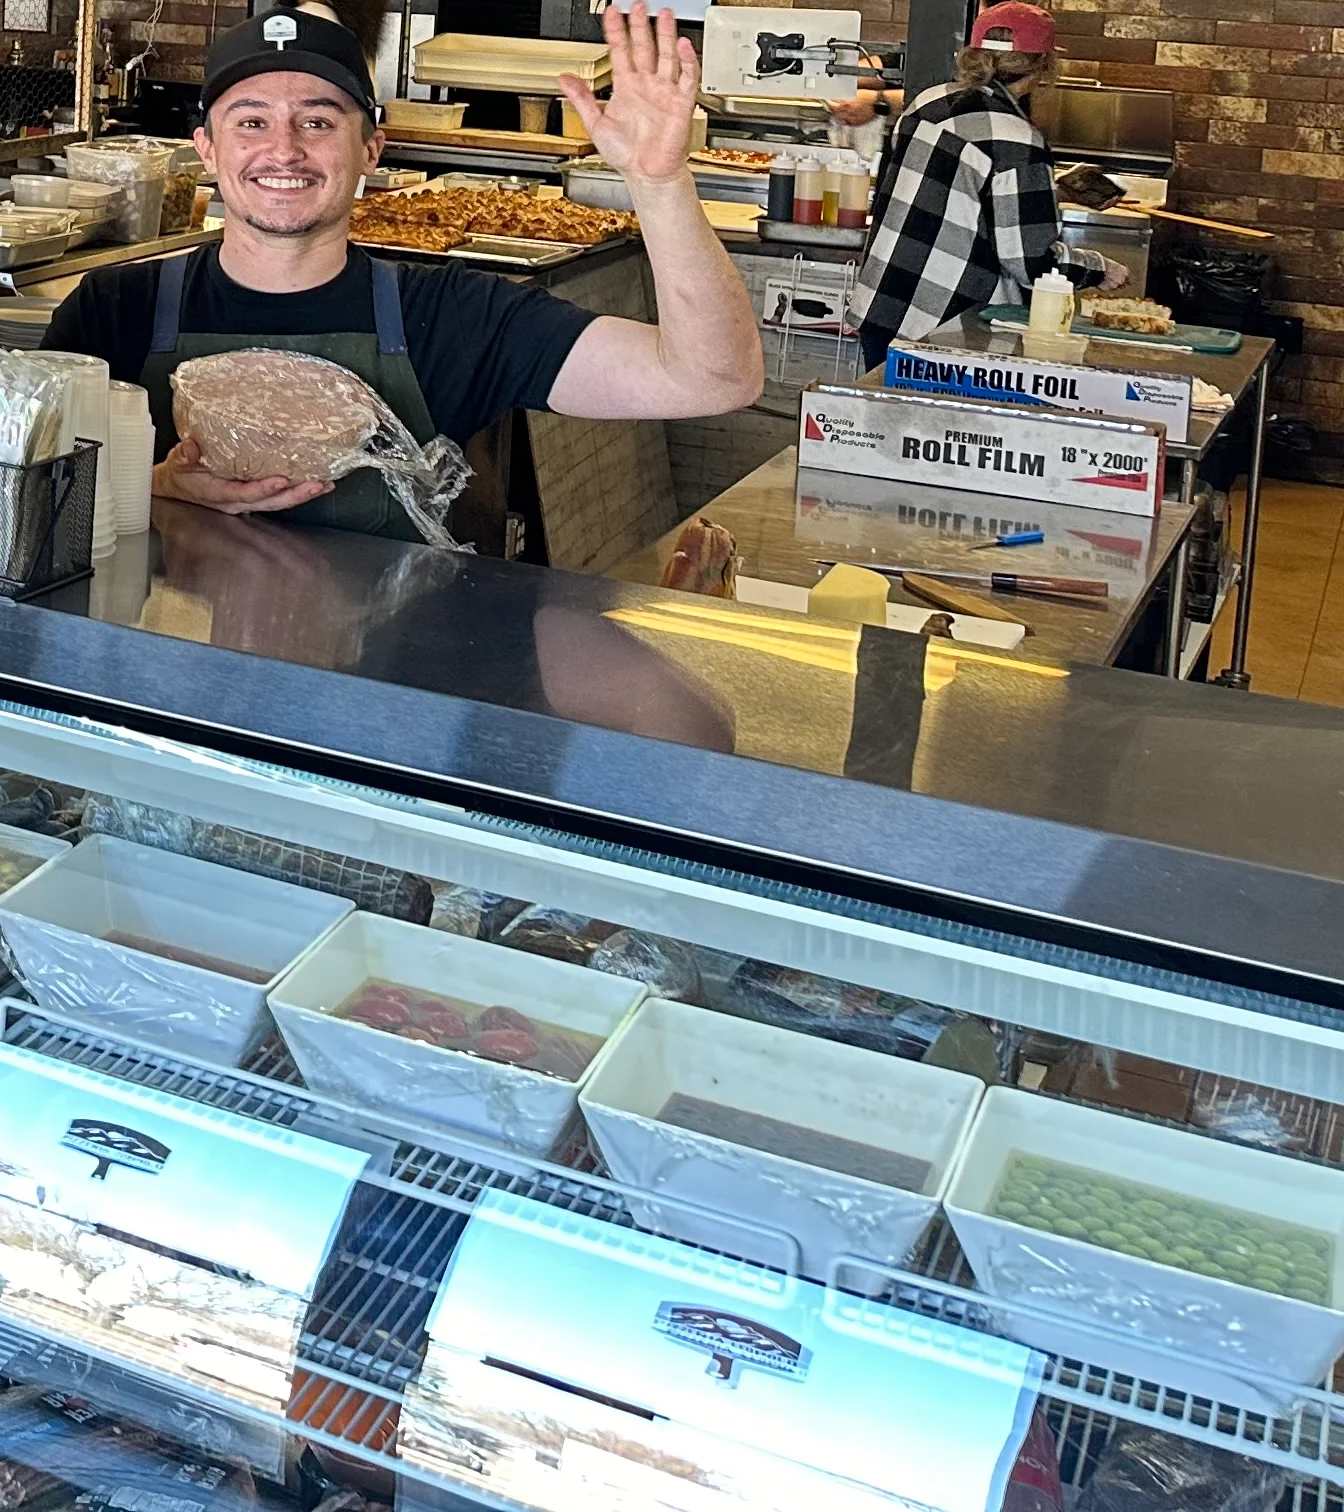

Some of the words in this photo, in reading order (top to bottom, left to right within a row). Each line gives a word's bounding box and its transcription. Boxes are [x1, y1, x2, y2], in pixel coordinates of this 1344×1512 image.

[897, 357, 968, 386] HEAVY
[972, 367, 1026, 394] ROLL
[1032, 373, 1080, 401] FOIL
[815, 412, 855, 428] Quality
[822, 423, 886, 441] Disposable
[829, 433, 877, 449] Products
[945, 429, 1003, 449] PREMIUM
[901, 435, 970, 468] ROLL
[977, 446, 1045, 478] FILM
